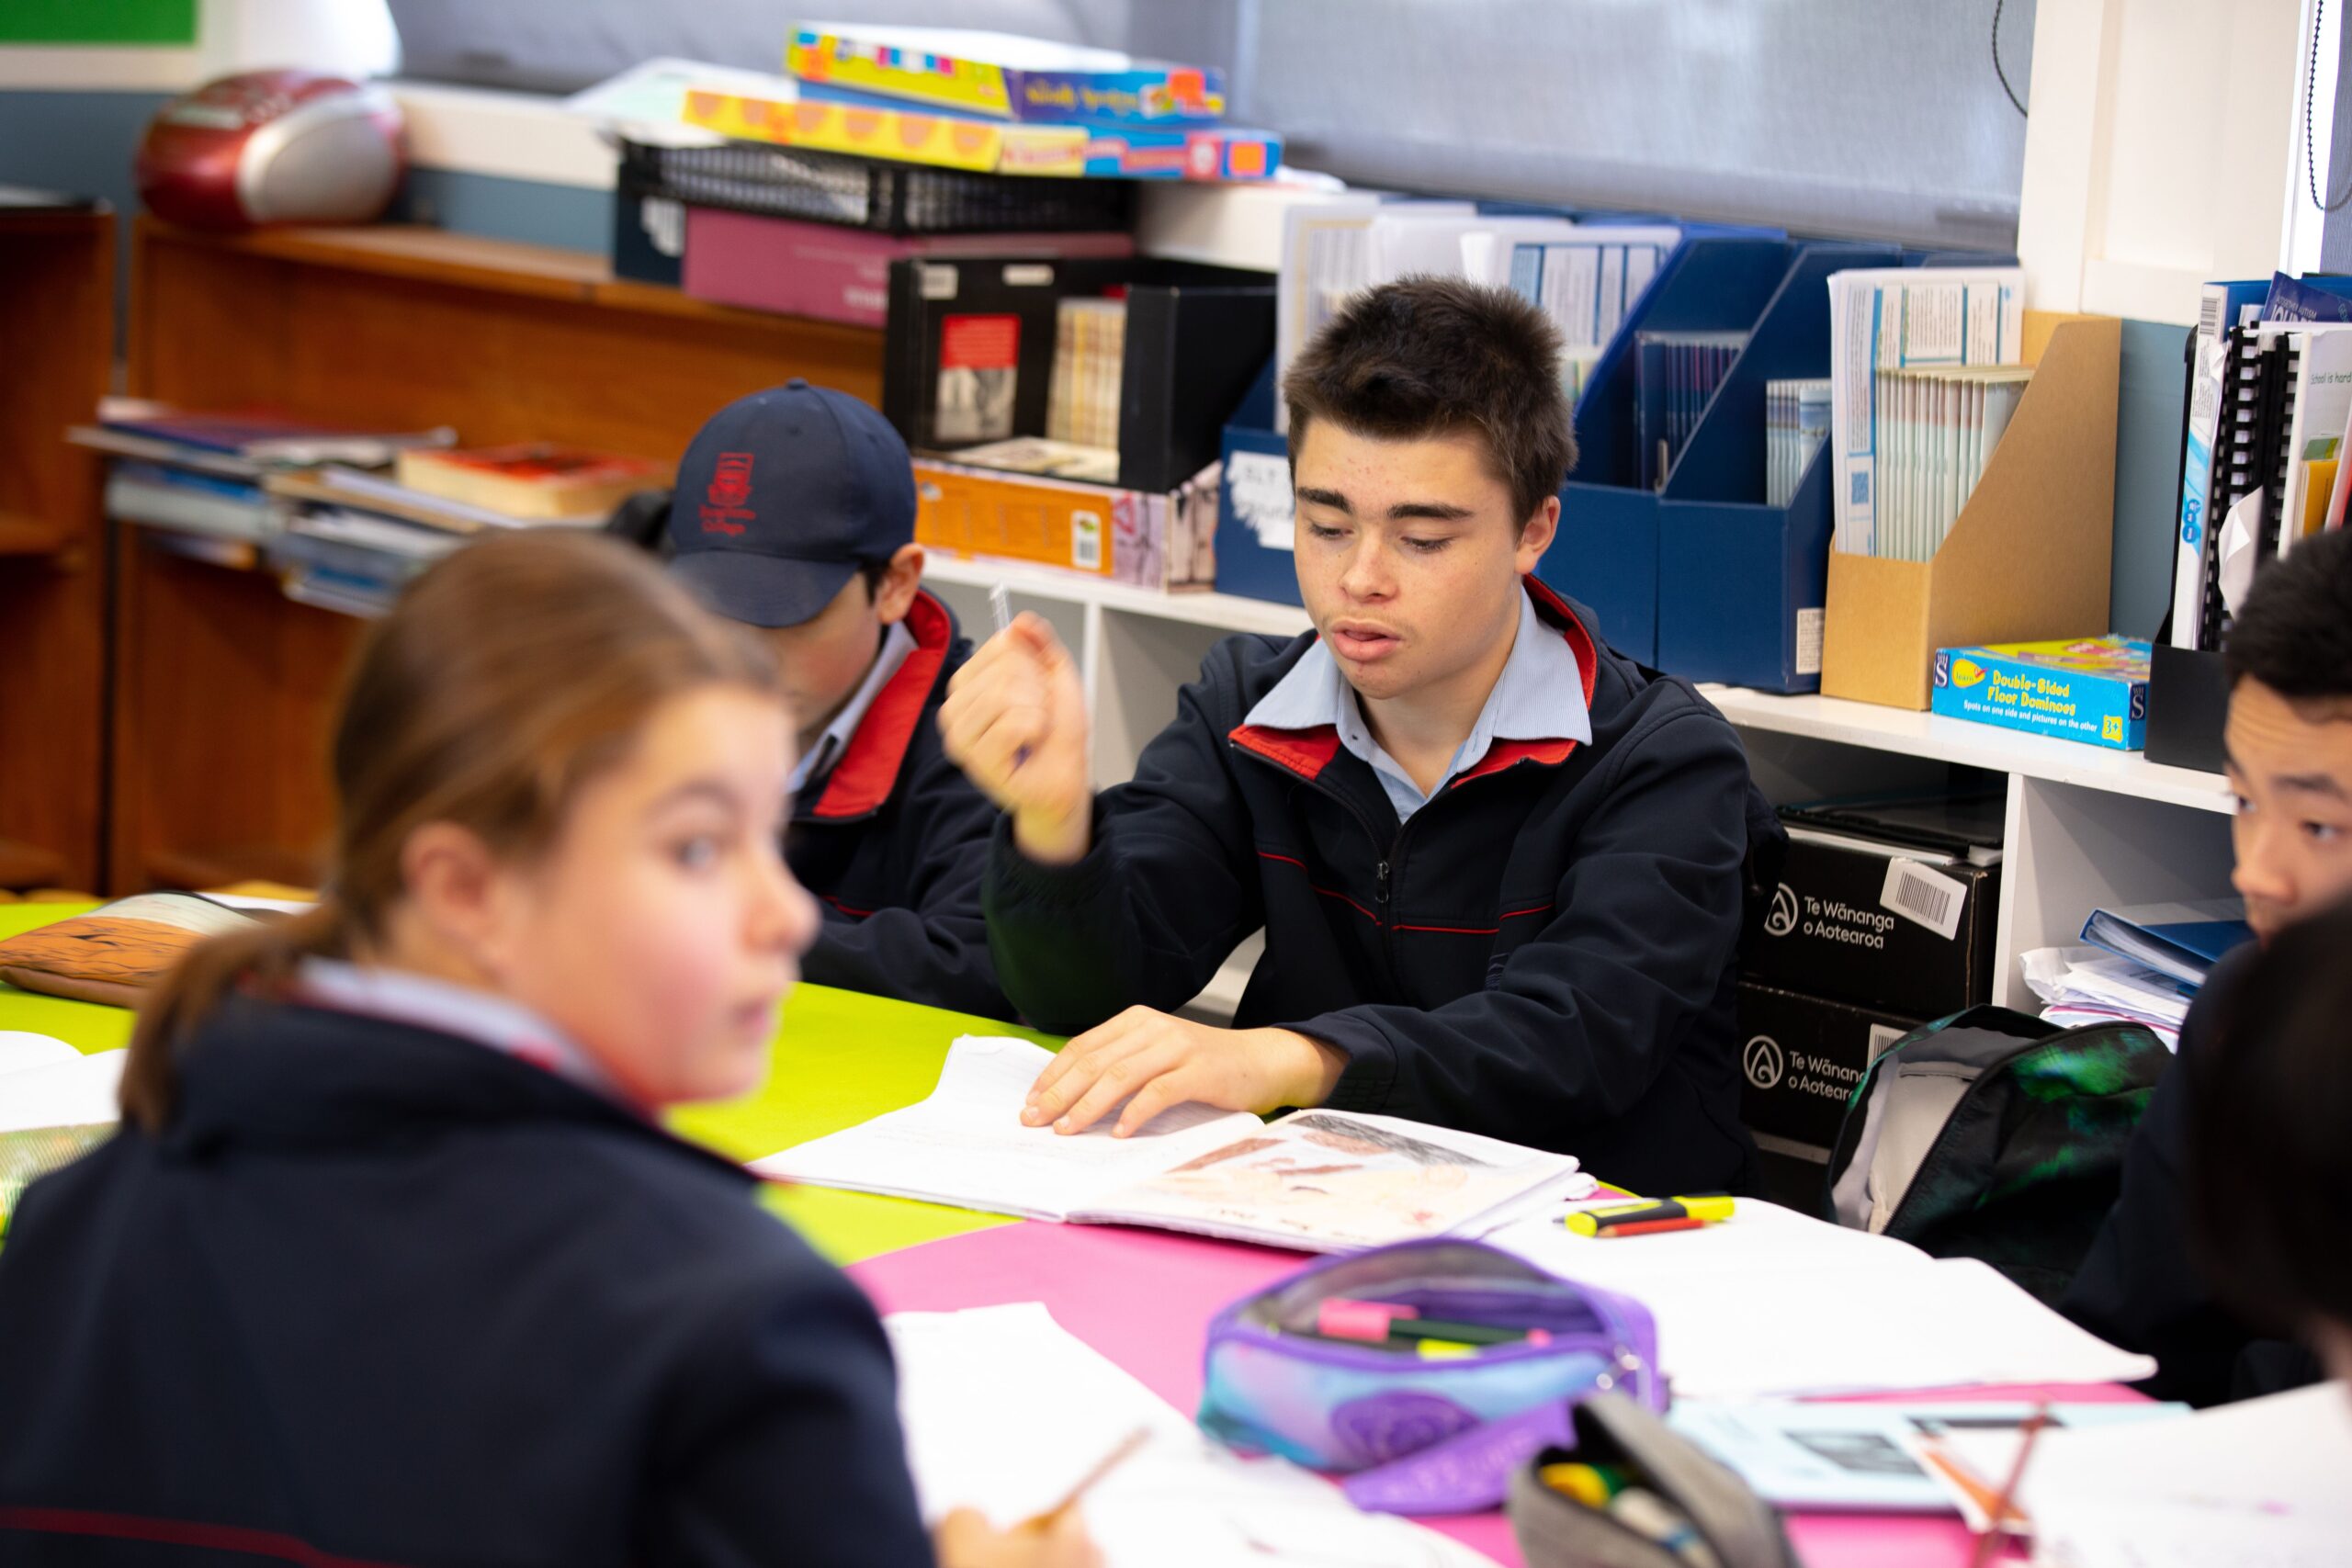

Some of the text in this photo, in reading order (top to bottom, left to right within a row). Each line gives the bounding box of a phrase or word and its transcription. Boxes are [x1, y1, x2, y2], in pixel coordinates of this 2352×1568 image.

[2327, 372, 2334, 384] is
[2335, 371, 2352, 383] hard
[1956, 671, 1974, 682] learn
[1993, 670, 2070, 698] Double-Sided
[1987, 685, 2076, 716] Floor Dominoes
[1963, 699, 2098, 732] Spots on one side and pictures on the other
[2106, 720, 2119, 735] 3+
[1804, 896, 1820, 916] Te
[1804, 919, 1883, 949] o Aotearoa
[1789, 1051, 1805, 1070] Te
[1788, 1076, 1798, 1089] o
